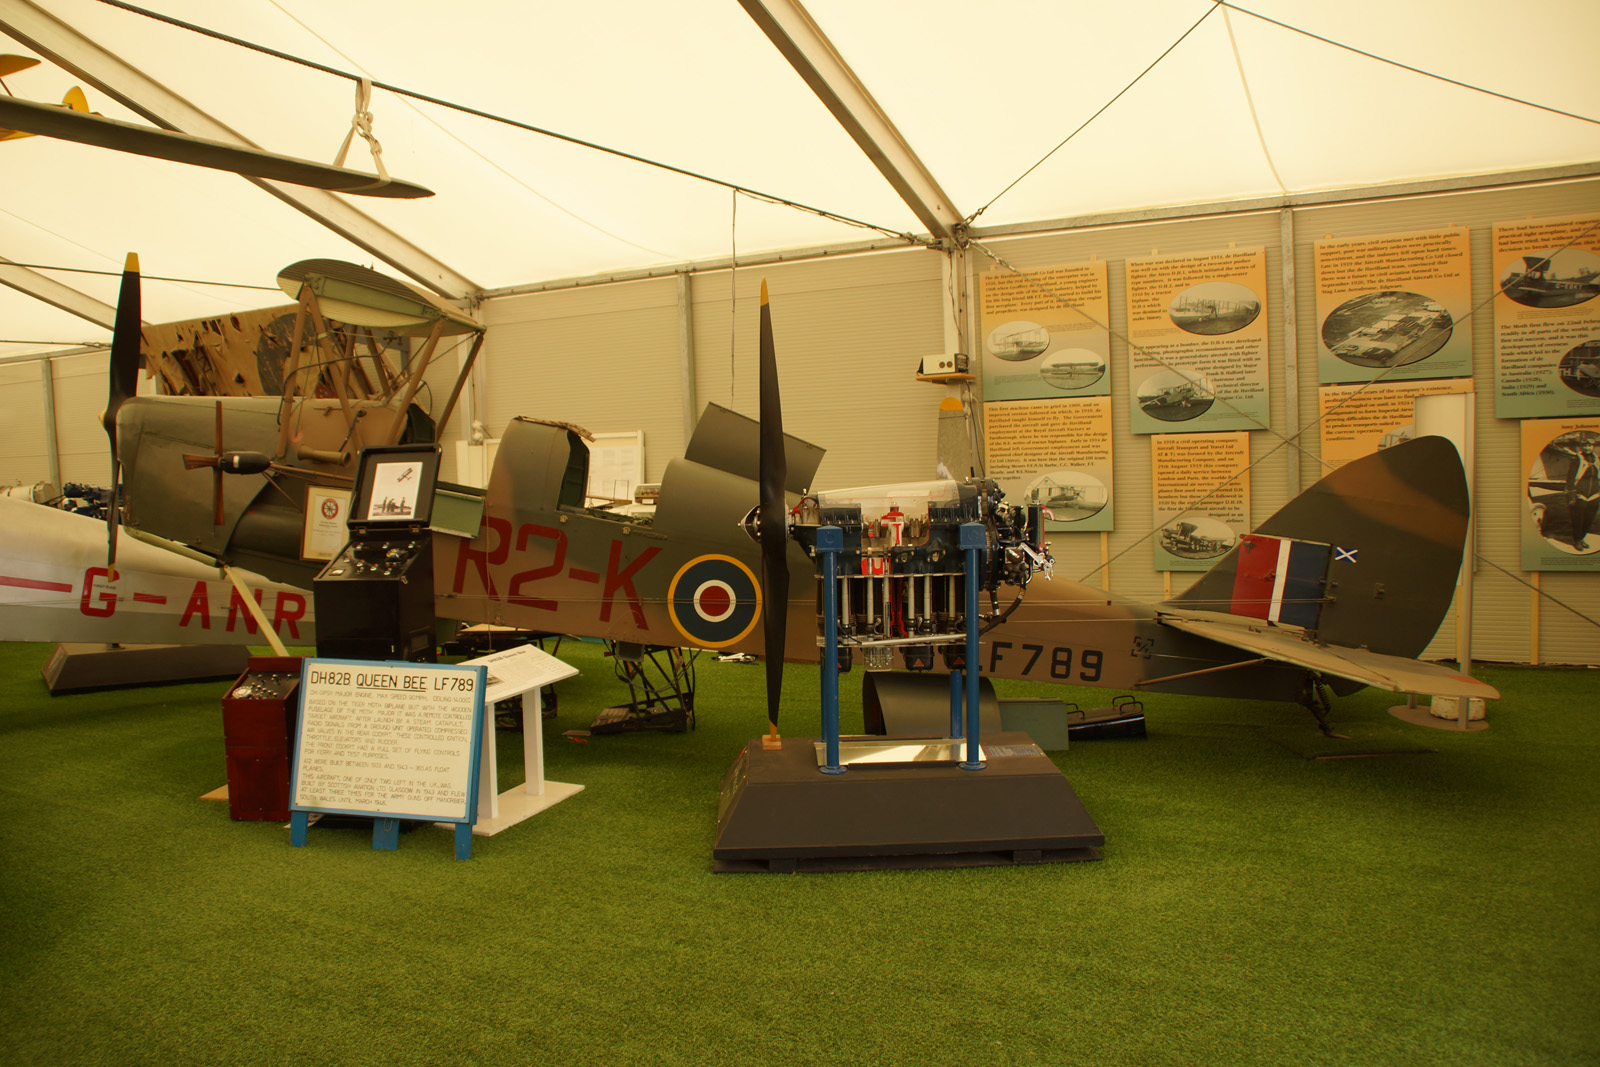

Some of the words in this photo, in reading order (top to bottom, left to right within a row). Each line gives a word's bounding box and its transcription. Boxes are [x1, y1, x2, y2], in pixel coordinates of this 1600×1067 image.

[452, 515, 663, 631] R2-K
[310, 670, 350, 685] DH82B
[356, 673, 397, 688] QUEEN
[403, 675, 427, 689] BEE
[434, 676, 474, 691] LF789
[977, 641, 1104, 682] F789
